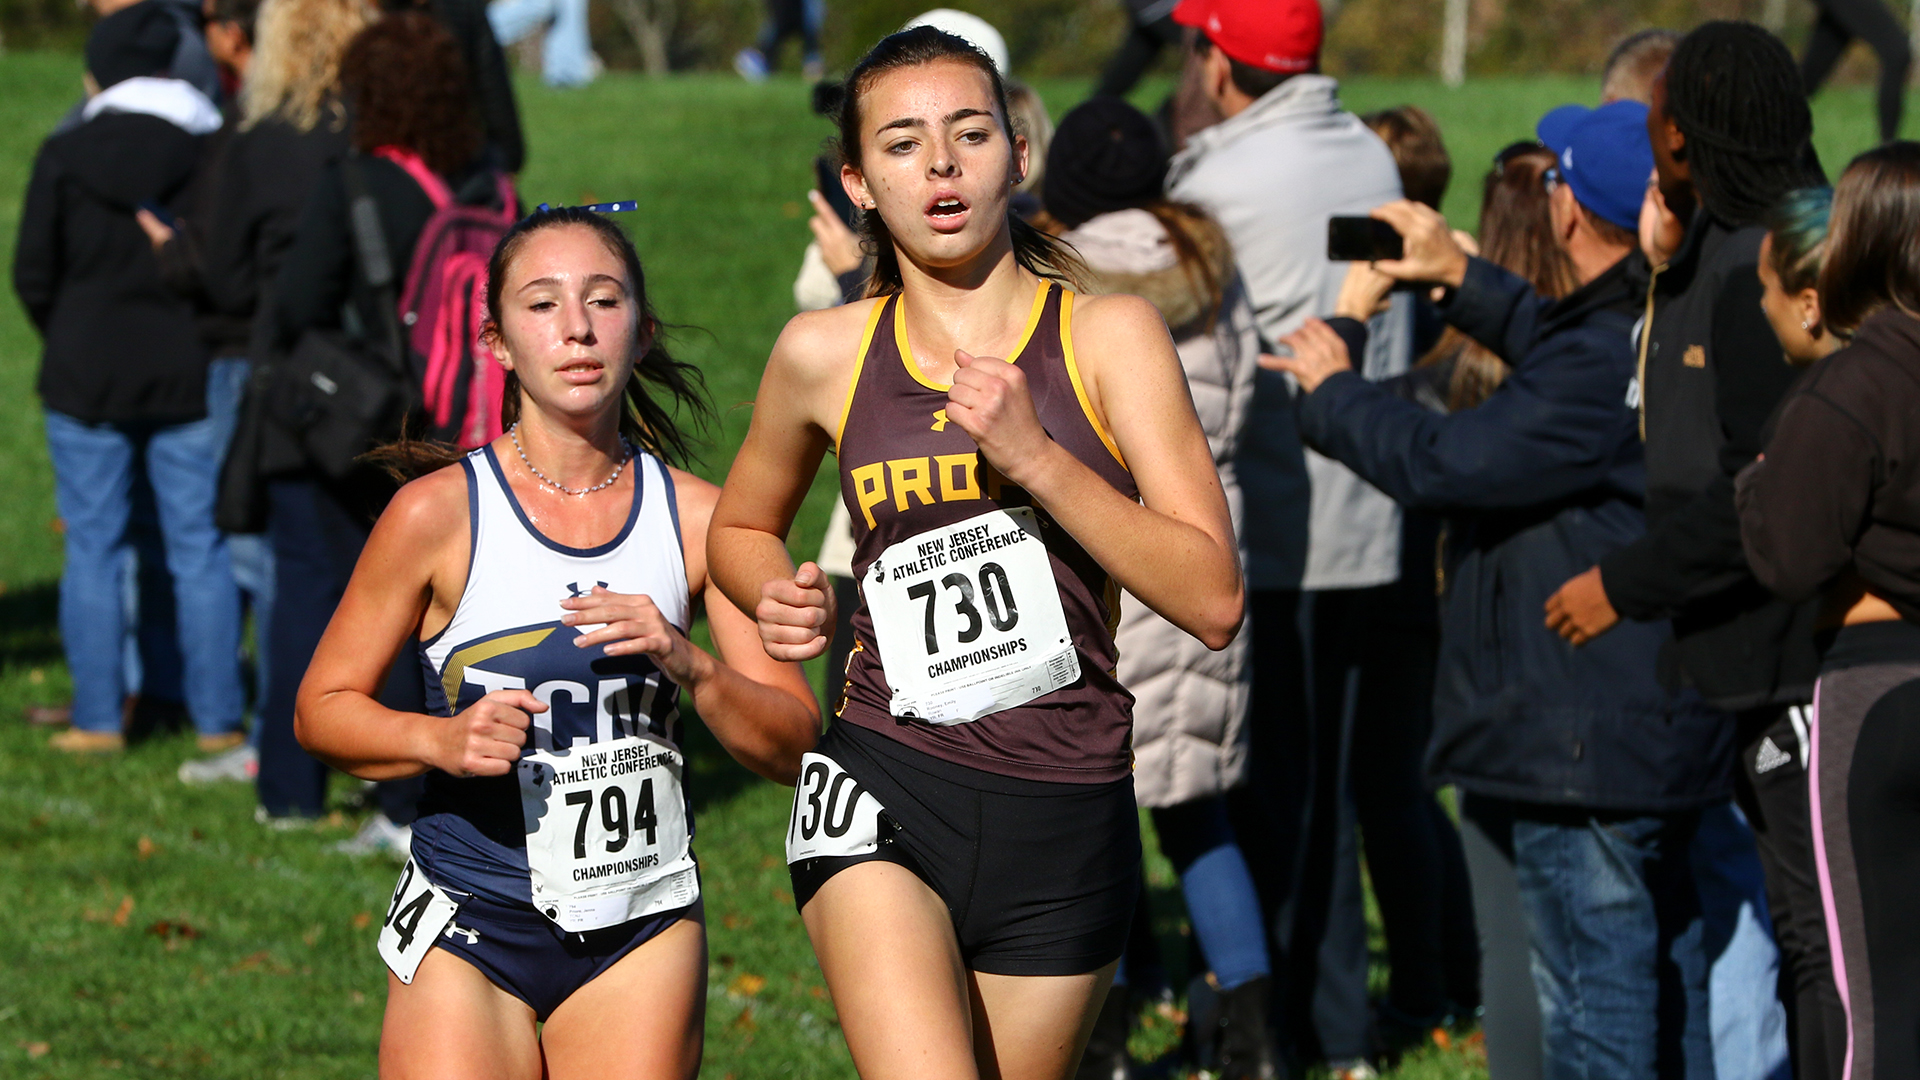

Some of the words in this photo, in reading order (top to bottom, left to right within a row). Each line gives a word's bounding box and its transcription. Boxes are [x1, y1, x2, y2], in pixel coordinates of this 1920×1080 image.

[851, 452, 1030, 531] PRO
[892, 552, 947, 581] ATHLETIC
[949, 528, 1028, 563] CONFERENCE
[917, 538, 945, 558] NEW
[948, 524, 990, 549] JERSEY
[907, 561, 1019, 656] 730
[927, 637, 1028, 679] CHAMPIONSHIPS
[553, 766, 608, 786] ATHLETIC
[610, 750, 674, 776] CONFERENCE
[581, 752, 607, 768] NEW
[611, 744, 650, 763] JERSEY
[565, 777, 657, 860] 794
[791, 762, 861, 844] 30
[572, 853, 659, 882] CHAMPIONSHIPS
